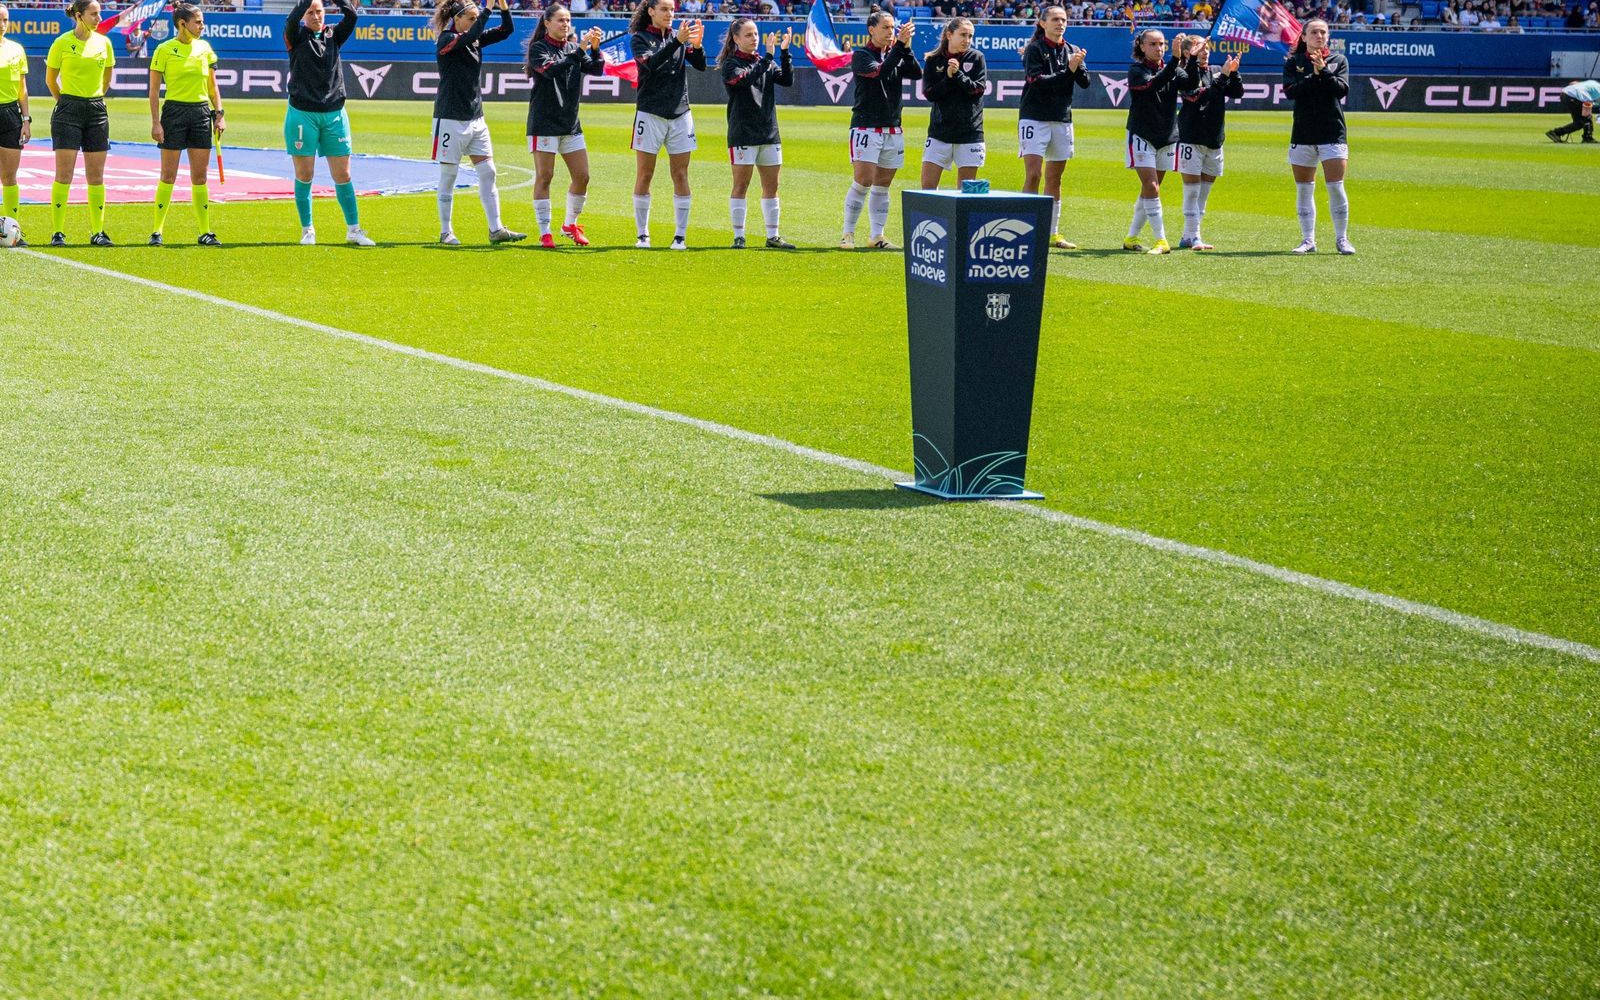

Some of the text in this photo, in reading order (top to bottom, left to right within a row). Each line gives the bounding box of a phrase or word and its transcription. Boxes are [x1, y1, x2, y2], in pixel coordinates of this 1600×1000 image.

[24, 21, 60, 34] CLUB
[203, 25, 272, 38] ARCELONA
[356, 25, 384, 40] MÉS
[387, 28, 413, 43] QUE
[1217, 21, 1264, 43] BATLLE
[975, 37, 989, 50] FC
[1219, 41, 1250, 53] CLUB
[1350, 43, 1435, 56] FC BARCELONA
[297, 124, 303, 140] 1
[637, 120, 645, 135] 5
[1021, 126, 1034, 140] 16
[442, 133, 450, 148] 2
[856, 133, 868, 149] 14
[1137, 138, 1147, 151] 17
[1181, 145, 1192, 160] 18
[916, 243, 945, 263] Liga F
[980, 244, 1029, 262] Liga F
[912, 262, 945, 283] moeve
[968, 264, 1030, 279] moeve
